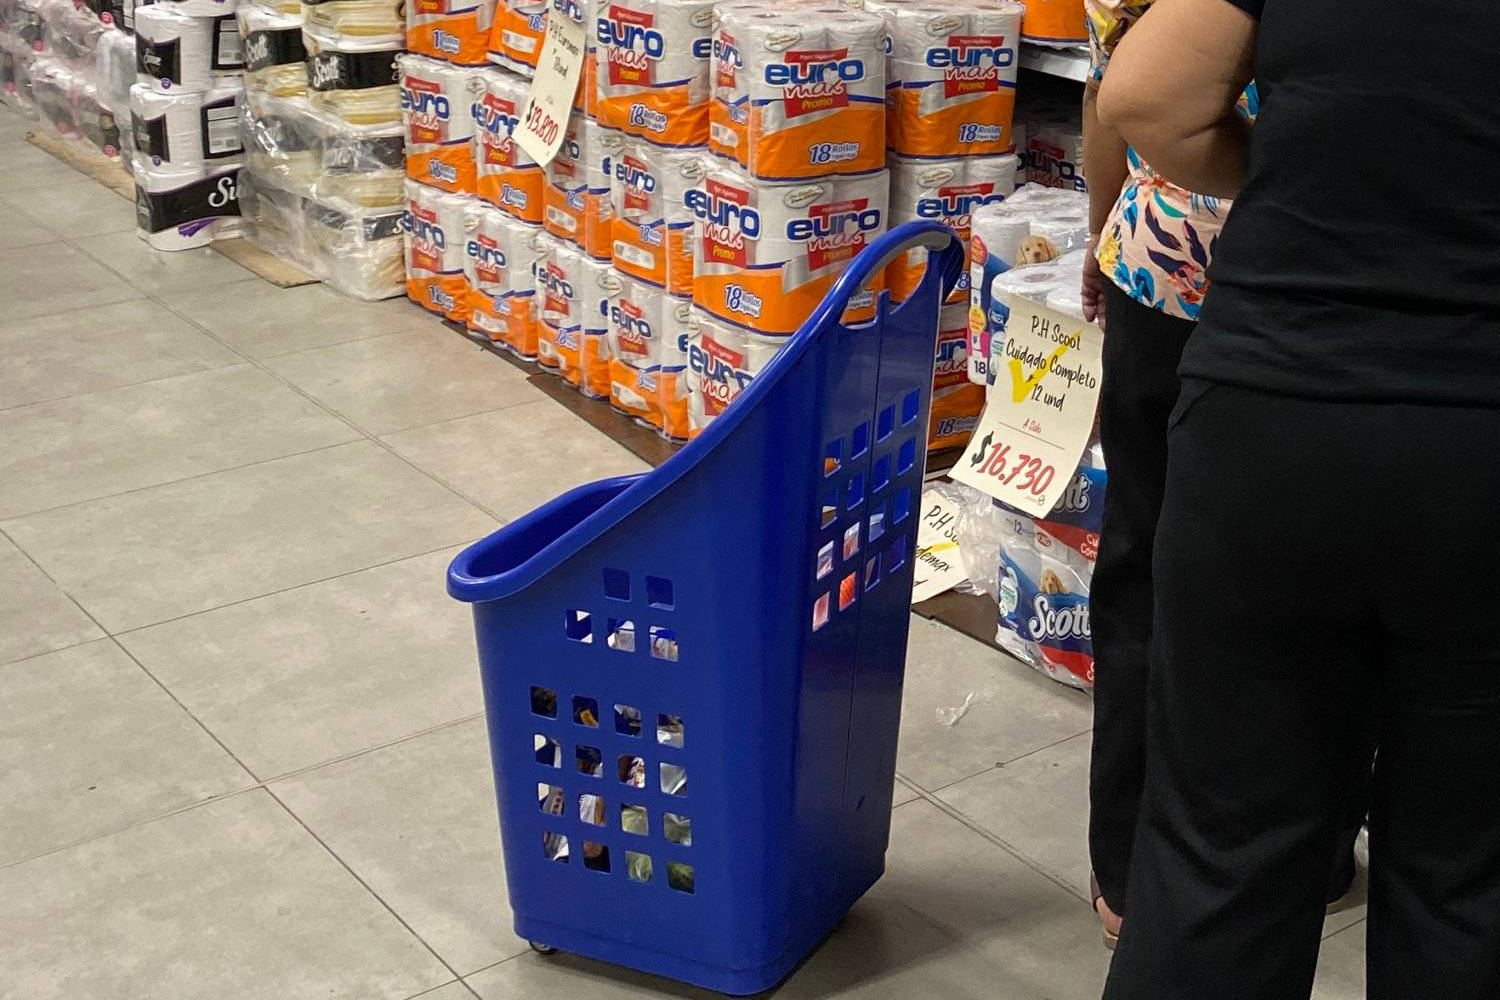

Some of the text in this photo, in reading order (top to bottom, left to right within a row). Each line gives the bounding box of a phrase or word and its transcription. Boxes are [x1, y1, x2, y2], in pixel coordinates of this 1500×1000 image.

[596, 18, 664, 59] euro
[713, 39, 744, 68] euro
[925, 47, 1013, 68] euro
[764, 59, 865, 86] euro
[959, 123, 976, 143] 18
[809, 144, 832, 164] 18
[614, 163, 655, 193] euro
[703, 222, 744, 250] max
[786, 208, 881, 242] euro
[466, 239, 507, 267] euro
[712, 246, 736, 260] Promo
[808, 233, 862, 251] max
[724, 284, 740, 310] 18
[611, 307, 652, 338] euro
[974, 360, 987, 374] 18
[1006, 338, 1096, 389] Cuidado Completo
[1031, 384, 1065, 411] 12 und
[970, 430, 1056, 496] $16.730
[1029, 595, 1092, 642] Scott
